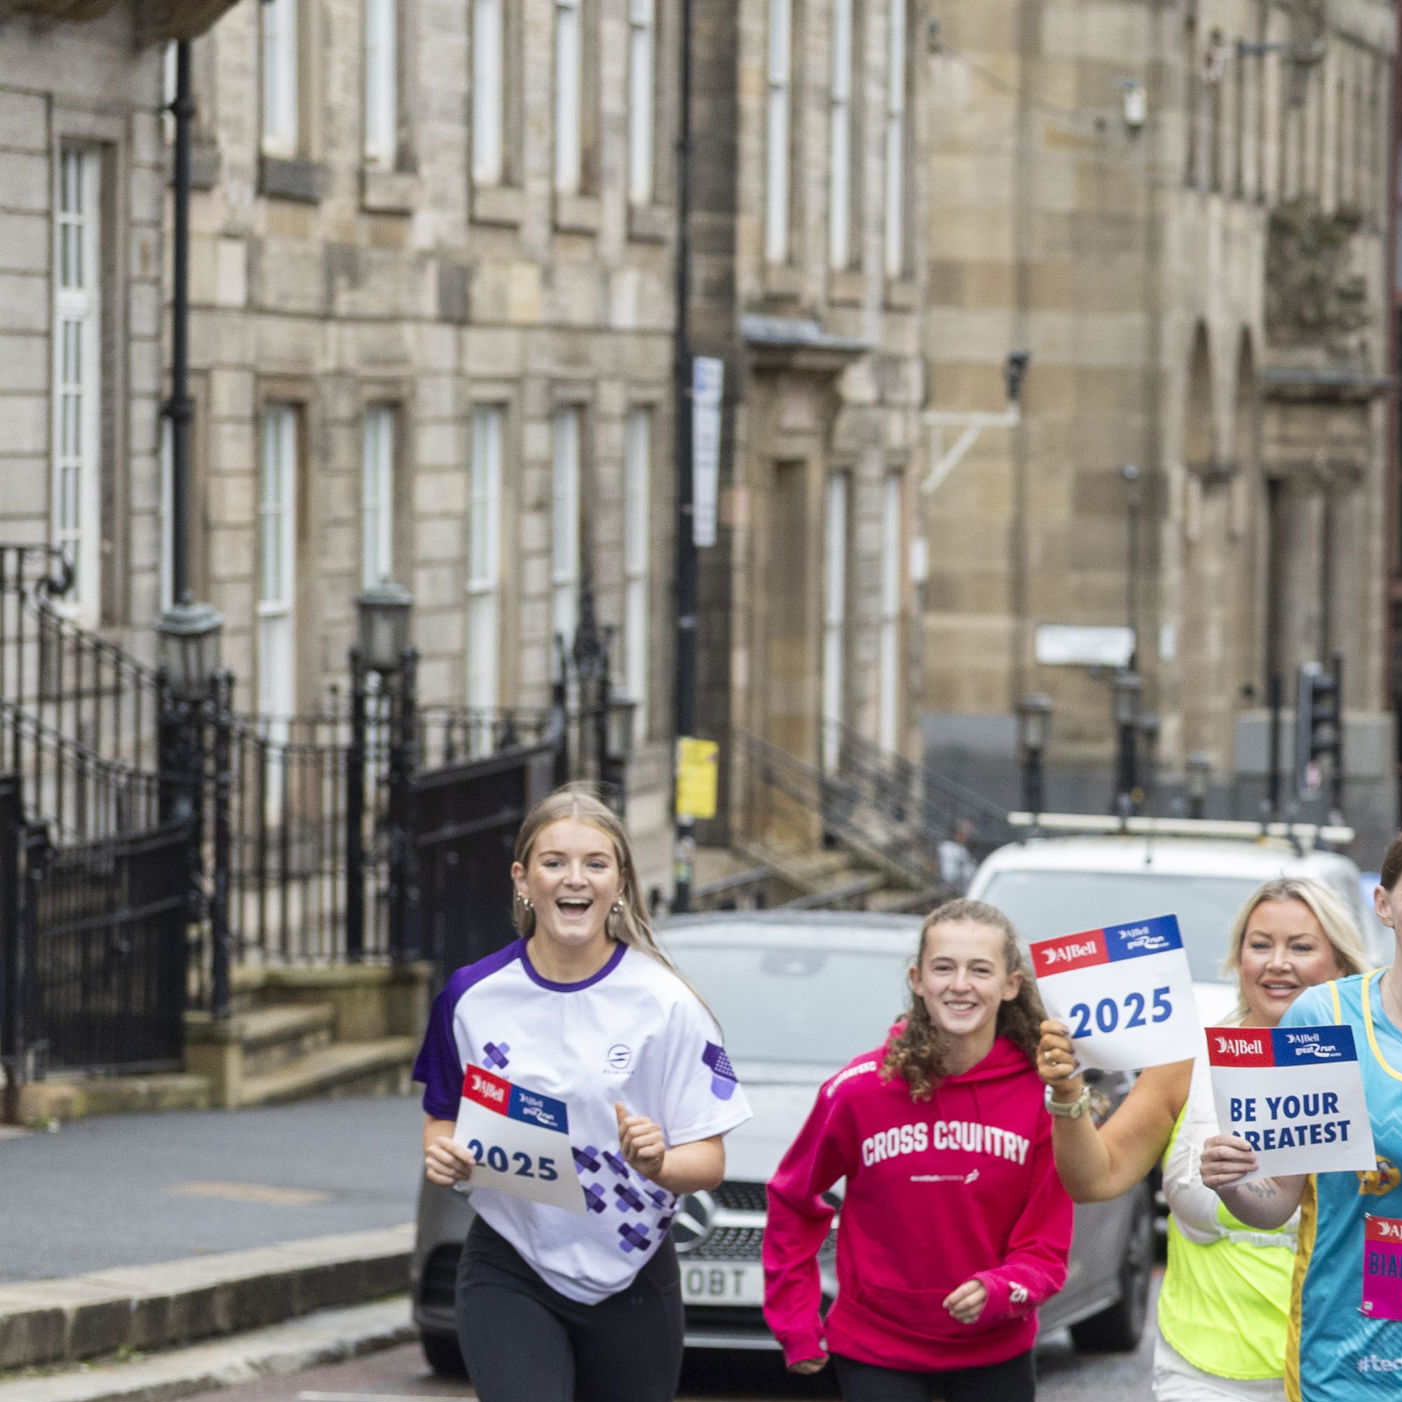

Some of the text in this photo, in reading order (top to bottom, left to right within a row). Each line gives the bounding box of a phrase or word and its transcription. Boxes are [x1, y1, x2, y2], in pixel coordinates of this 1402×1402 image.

[1056, 940, 1097, 962] AJBell
[1069, 986, 1173, 1039] 2025
[1228, 1039, 1263, 1057] AJBell
[1230, 1092, 1339, 1122] BE YOUR
[862, 1120, 1029, 1167] CROSS COUNTRY
[1232, 1120, 1351, 1151] REATEST
[467, 1139, 558, 1181] 2025
